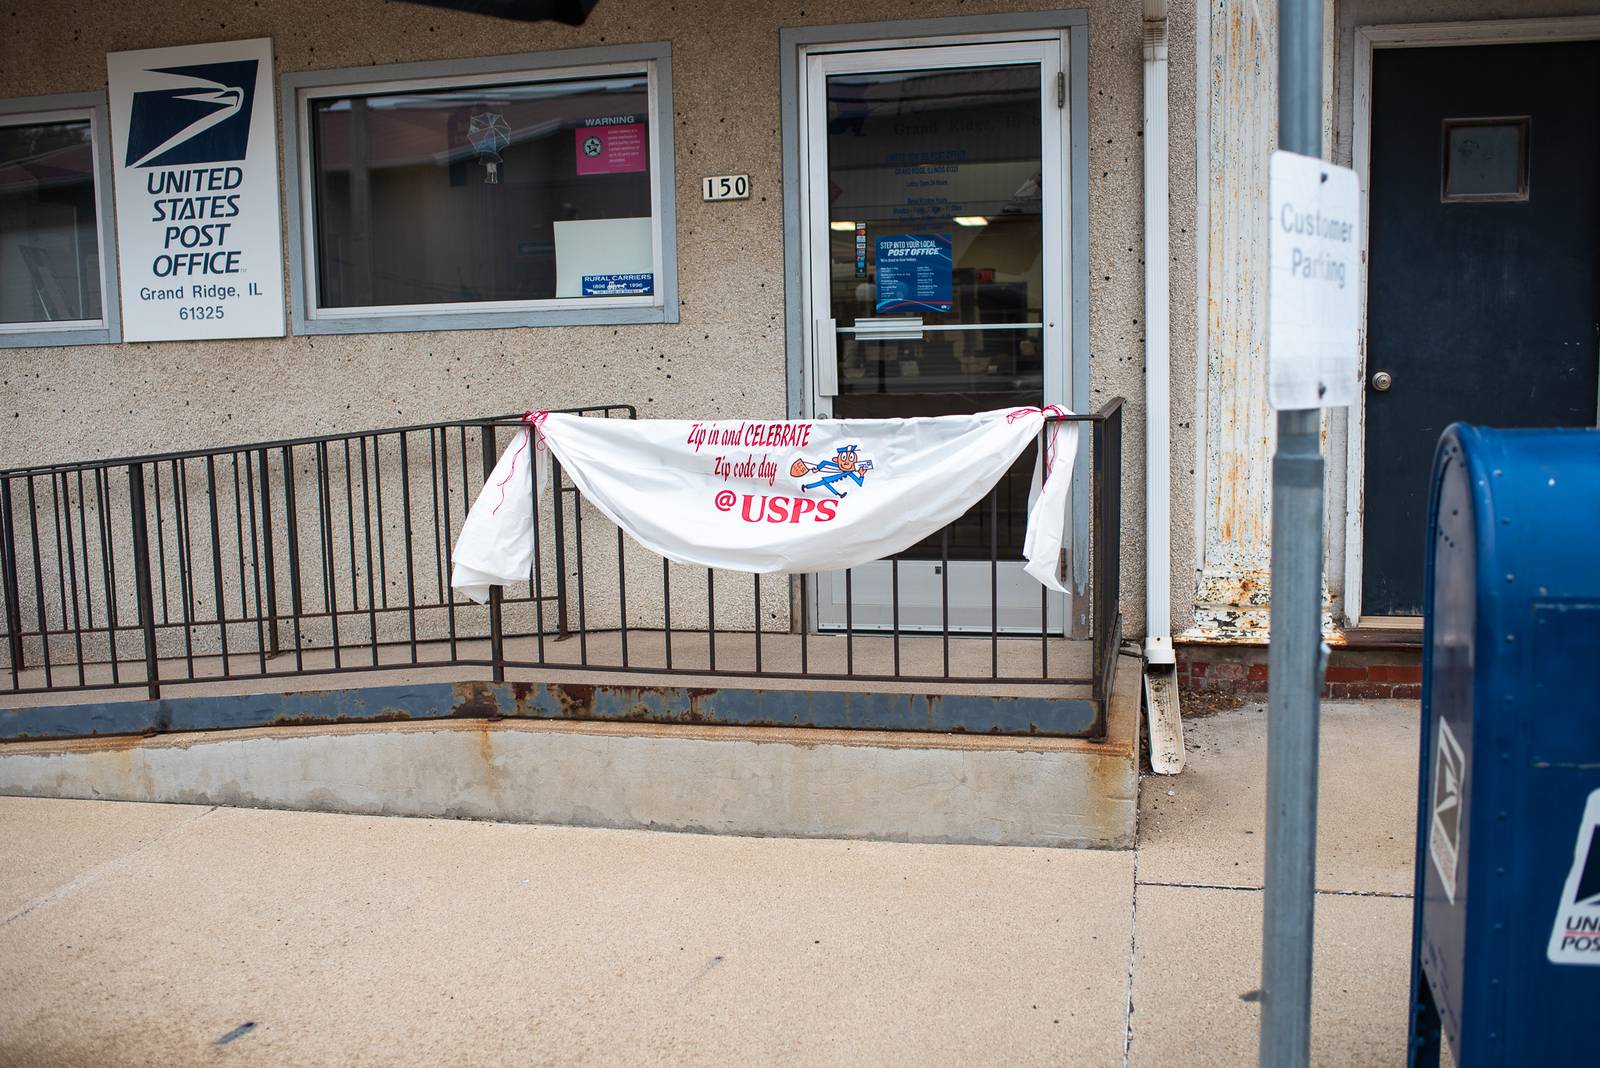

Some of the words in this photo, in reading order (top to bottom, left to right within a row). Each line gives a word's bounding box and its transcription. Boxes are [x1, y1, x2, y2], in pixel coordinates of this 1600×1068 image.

[585, 116, 635, 126] WARNING
[147, 167, 243, 195] UNITED
[708, 176, 746, 198] 150
[152, 195, 240, 222] STATES
[164, 223, 231, 249] POST
[1281, 203, 1353, 243] Customer
[893, 241, 906, 249] INTO
[906, 240, 920, 249] YOUR
[920, 240, 936, 248] LOCAL
[911, 248, 939, 256] OFFICE
[152, 251, 242, 277] OFFICE
[1291, 248, 1346, 289] Parking
[140, 286, 184, 300] Grand
[192, 284, 240, 300] Ridge,
[248, 282, 263, 296] IL
[179, 306, 224, 320] 61325
[687, 423, 706, 453] Zip
[707, 422, 719, 446] in
[721, 421, 744, 447] and
[744, 423, 812, 448] CELEBRATE
[714, 456, 731, 482] Zip
[733, 454, 757, 479] code
[757, 453, 778, 487] day
[714, 489, 737, 512] @
[741, 494, 839, 524] USPS
